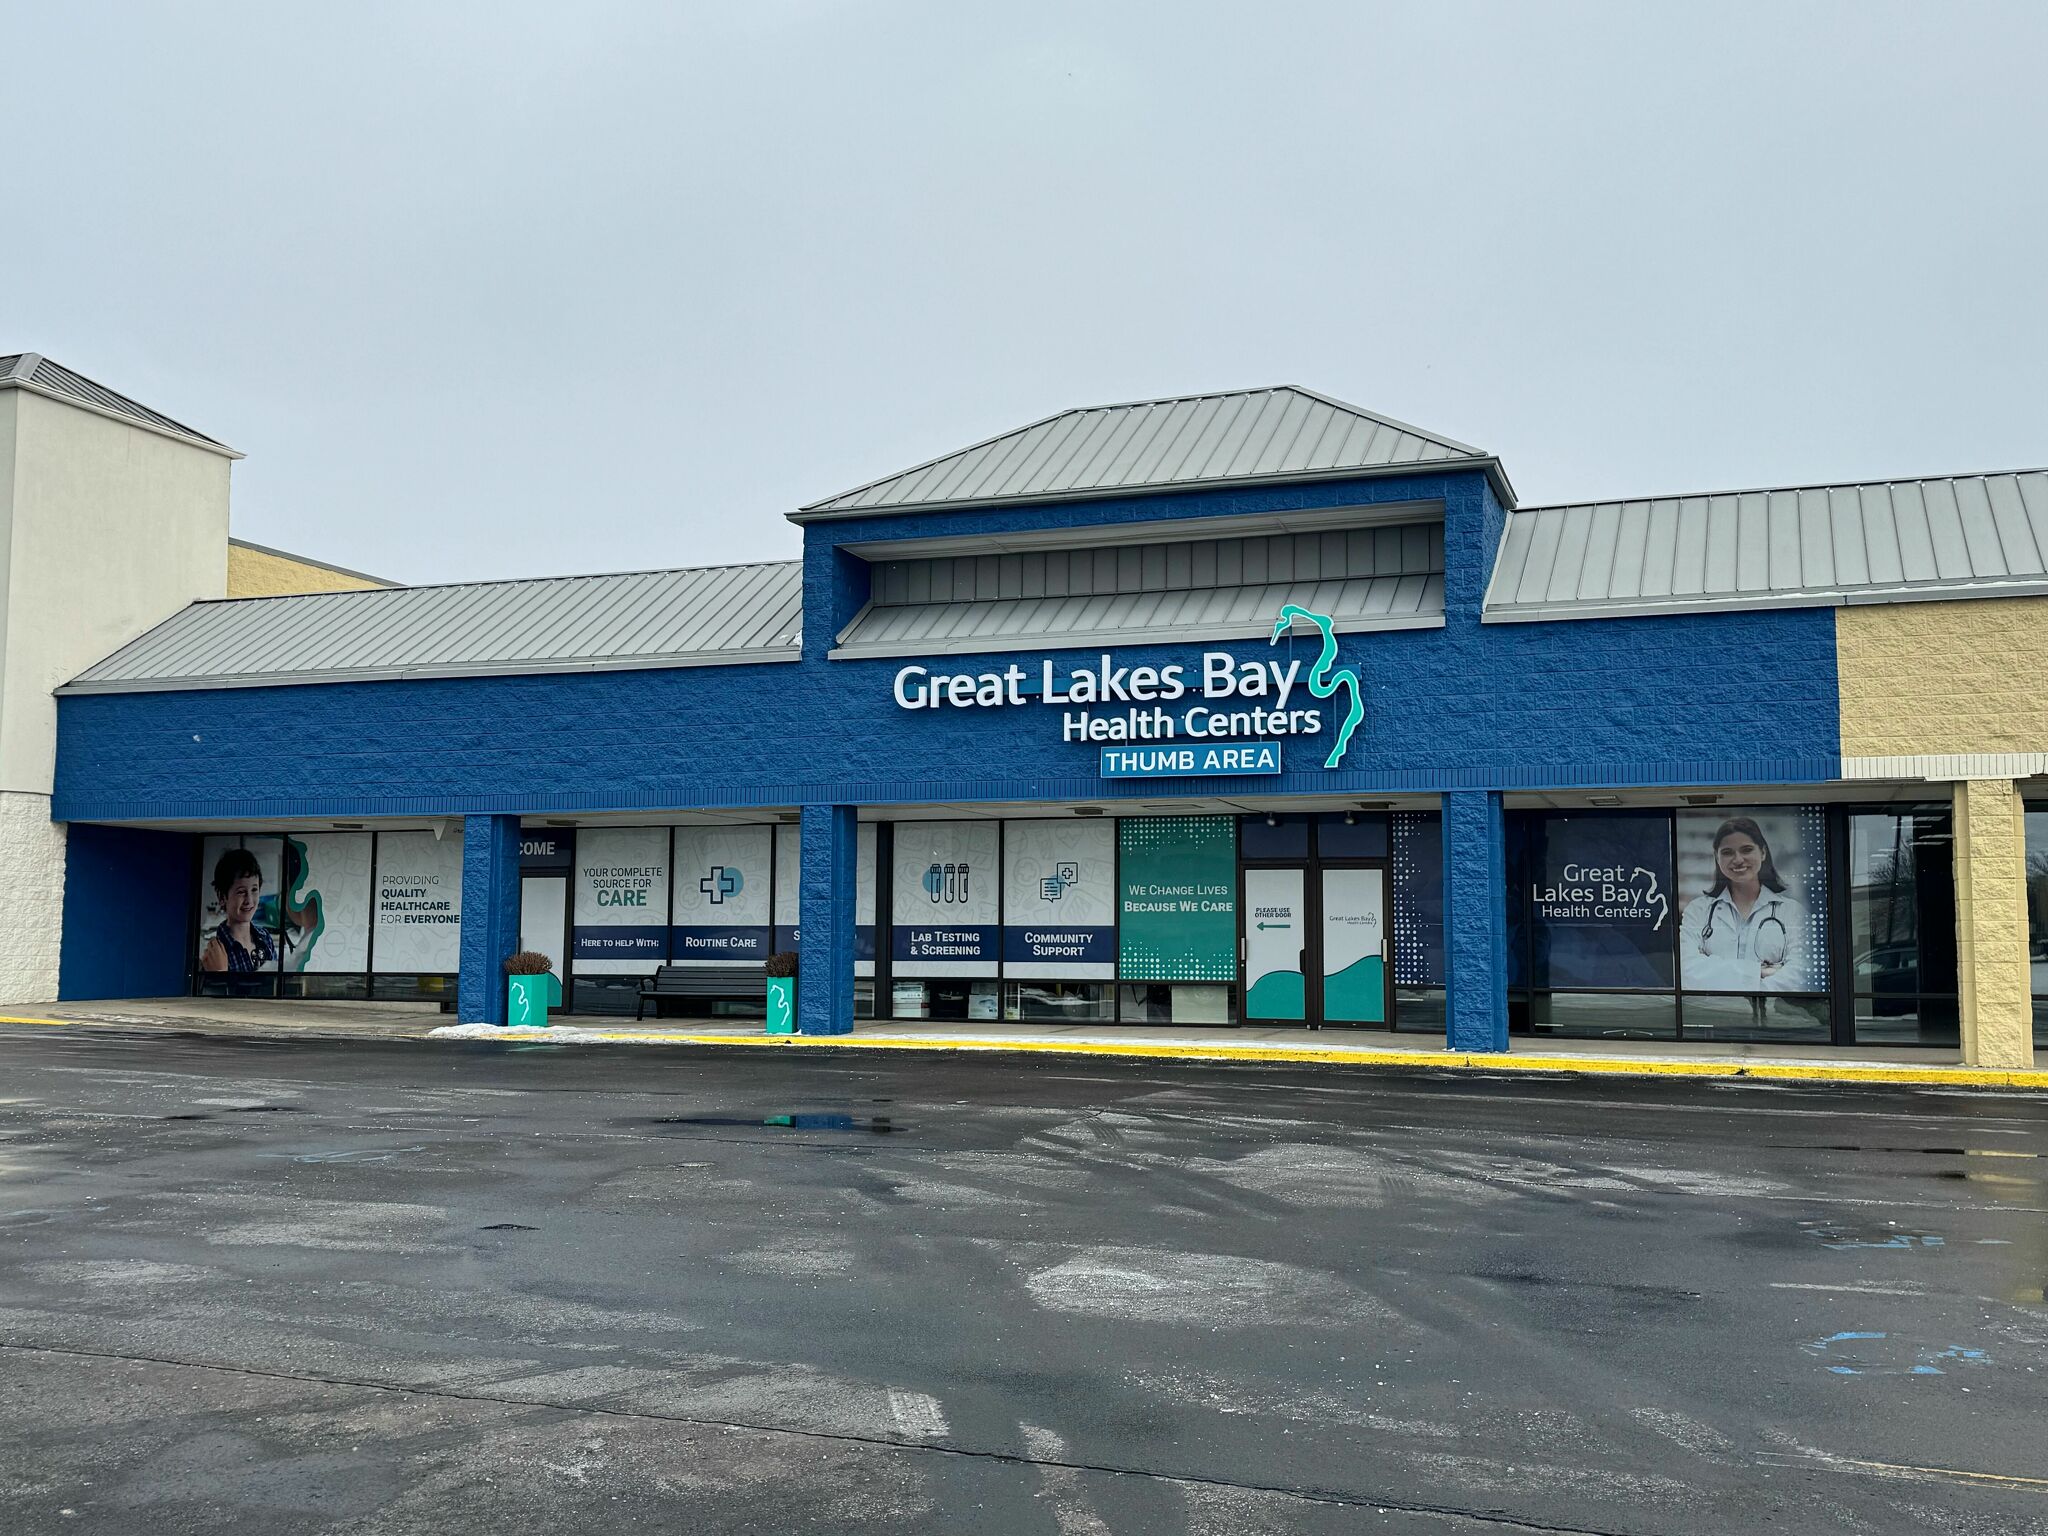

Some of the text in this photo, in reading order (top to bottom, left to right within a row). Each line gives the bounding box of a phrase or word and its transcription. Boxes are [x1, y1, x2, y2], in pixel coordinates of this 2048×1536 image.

[894, 652, 1301, 709] Great Lakes Bay
[1063, 706, 1322, 742] Health Centers
[1105, 748, 1275, 772] THUMB AREA
[583, 866, 663, 878] YOUR COMPLETE
[1563, 864, 1625, 882] Great
[382, 875, 439, 885] PROVIDING
[593, 878, 652, 888] SOURCE FOR
[381, 888, 427, 898] QUALITY
[596, 889, 648, 907] CARE
[1533, 882, 1643, 908] Lakes Bay
[381, 901, 451, 911] HEALTHCARE
[1542, 904, 1652, 918] Health Centers
[380, 914, 461, 924] FOR EVERYONE
[910, 945, 919, 955] &
